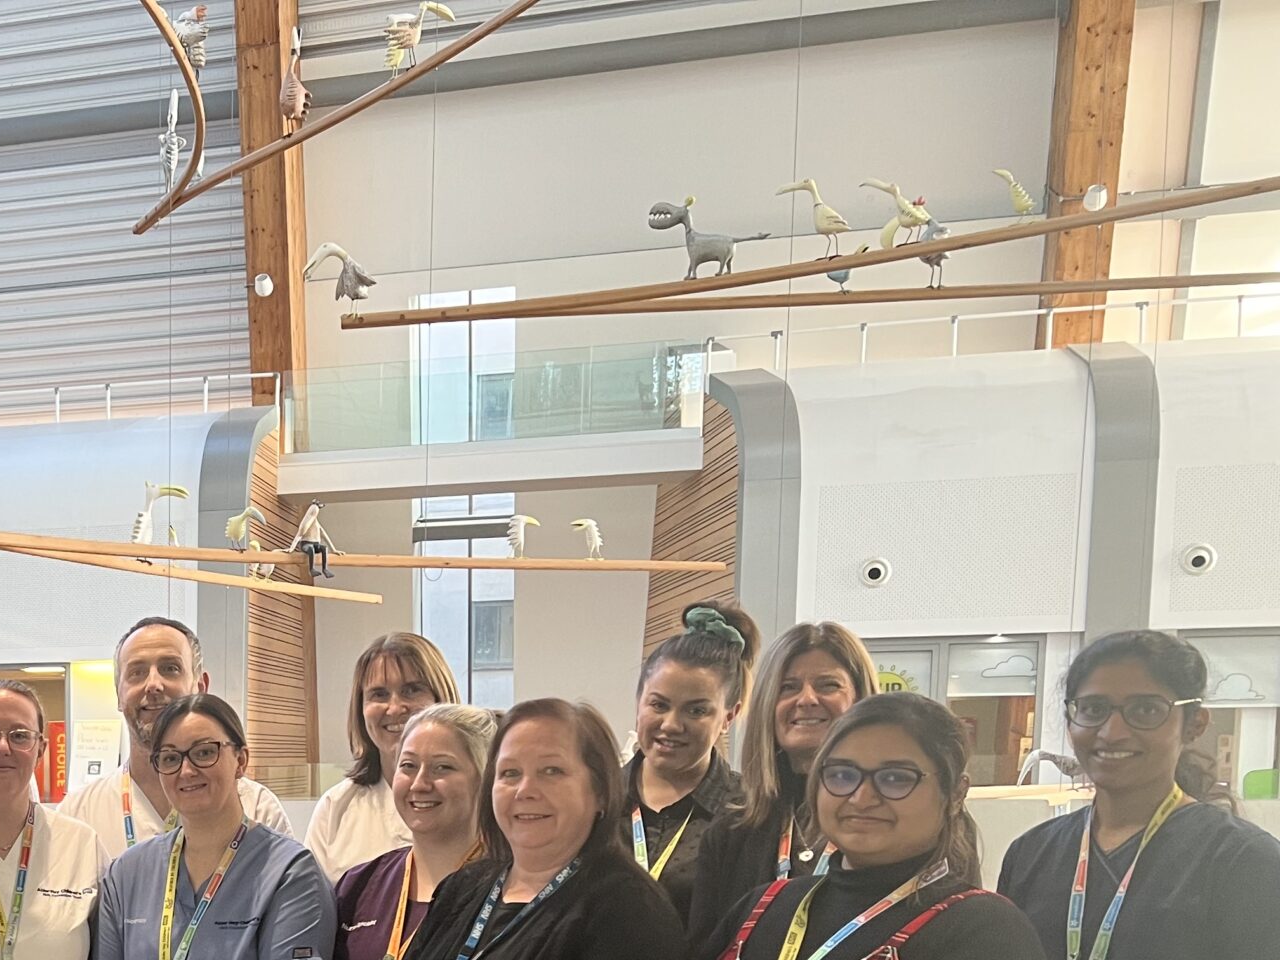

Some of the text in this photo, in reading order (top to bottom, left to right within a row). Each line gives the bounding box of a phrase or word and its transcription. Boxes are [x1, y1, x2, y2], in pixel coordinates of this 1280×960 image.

[56, 733, 66, 788] CHOICE
[490, 884, 501, 902] NHS
[481, 903, 493, 920] NHS
[471, 922, 485, 940] NHS
